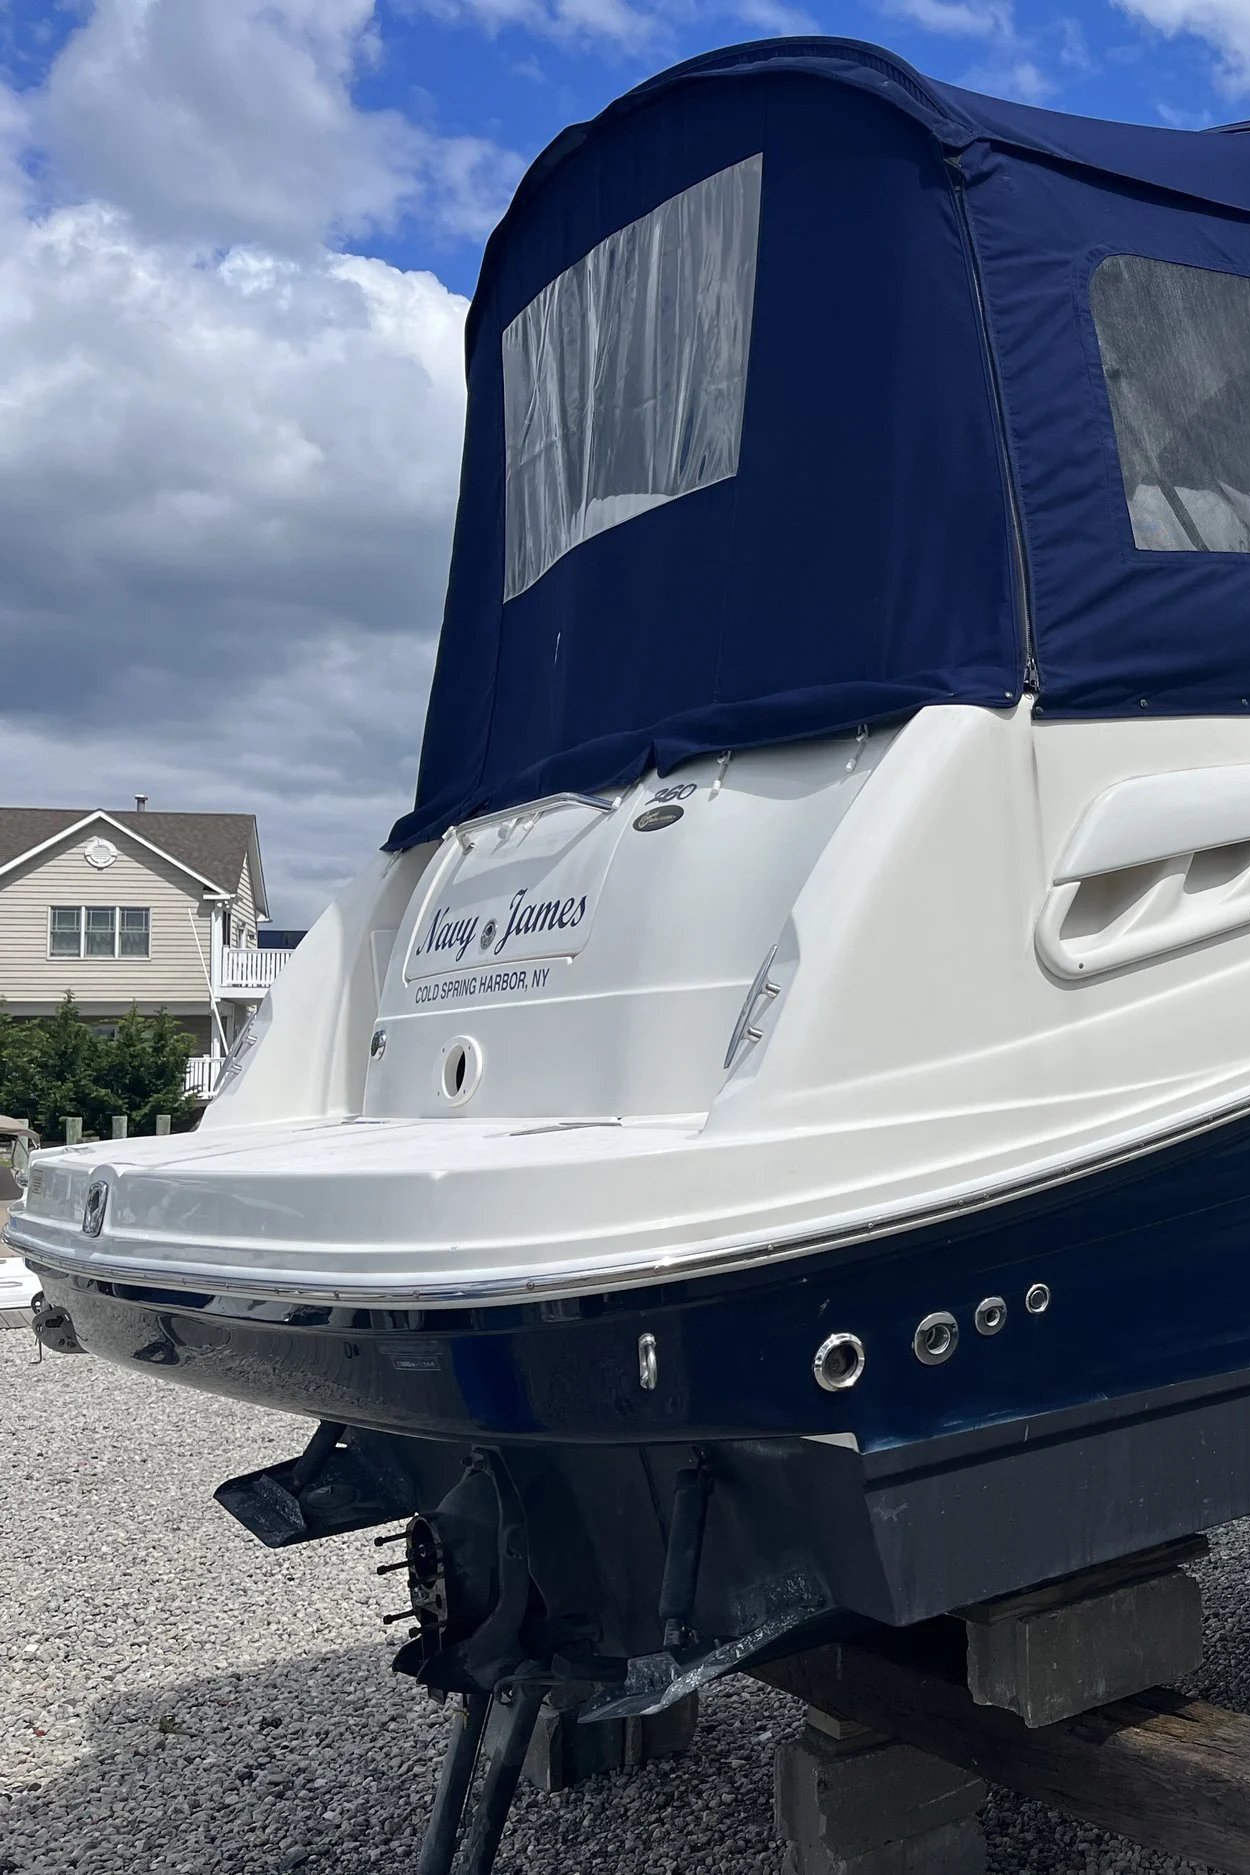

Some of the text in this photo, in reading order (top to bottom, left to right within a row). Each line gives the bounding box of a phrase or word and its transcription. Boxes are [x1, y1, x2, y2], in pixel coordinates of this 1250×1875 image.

[645, 783, 698, 805] 260
[416, 888, 587, 962] Navy James
[415, 968, 550, 1004] COLD SPRING HARBOR, NY
